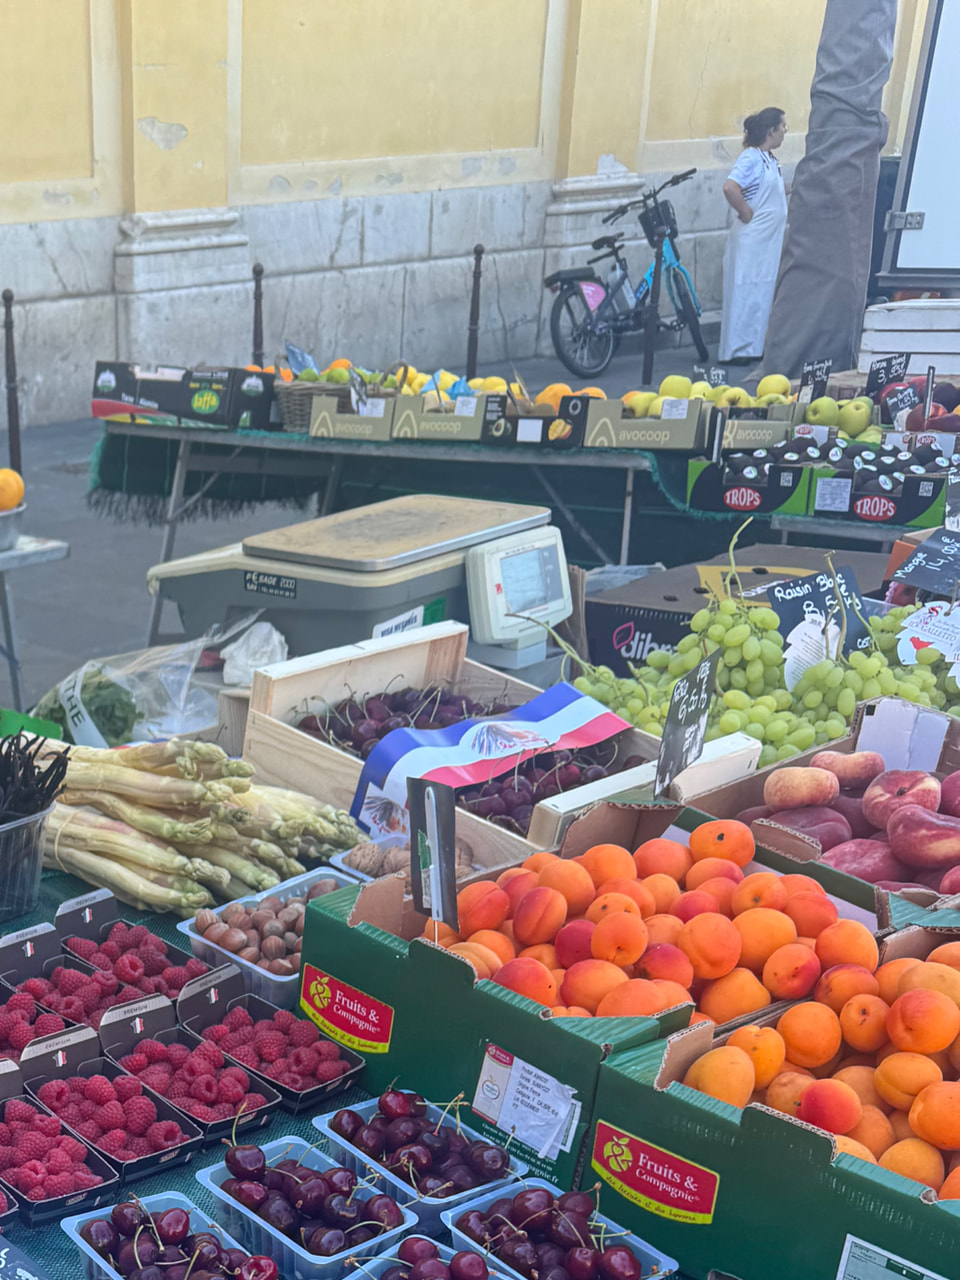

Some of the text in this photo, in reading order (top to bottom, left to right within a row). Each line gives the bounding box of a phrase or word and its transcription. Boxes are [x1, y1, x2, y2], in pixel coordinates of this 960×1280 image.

[419, 419, 462, 434] avocoop
[619, 428, 670, 445] avocoop
[736, 427, 773, 443] avocoop
[724, 487, 762, 508] TROPS
[854, 496, 897, 518] TROPS
[774, 579, 813, 603] Raisin
[123, 1003, 149, 1016] PREMIUM
[335, 989, 380, 1023] Fruits &
[333, 1004, 377, 1034] Compagnie
[44, 1037, 72, 1050] PREMIUM
[637, 1152, 698, 1192] Fruits &
[635, 1168, 695, 1203] Compagnie
